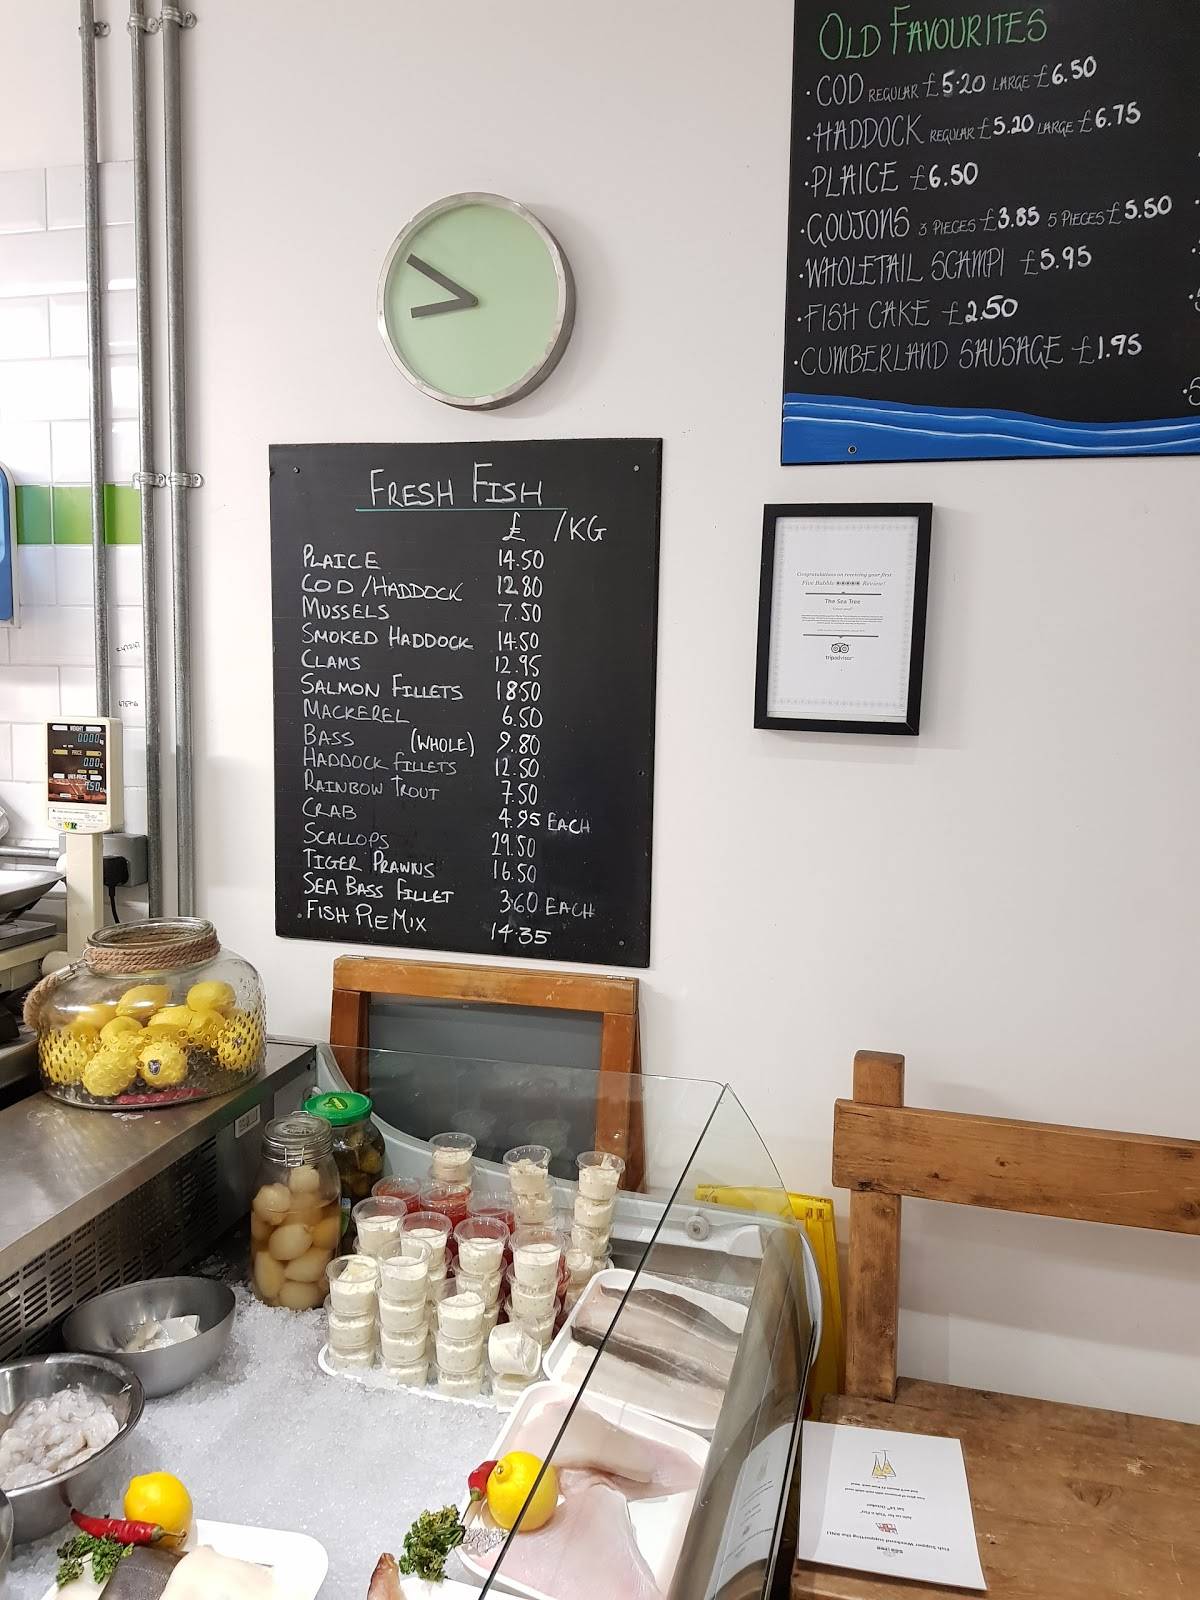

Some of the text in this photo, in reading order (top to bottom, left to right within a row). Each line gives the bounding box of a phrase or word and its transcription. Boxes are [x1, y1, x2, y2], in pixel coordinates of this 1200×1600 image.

[819, 5, 1047, 60] OLD FAVOURITES
[817, 73, 863, 106] COD
[869, 84, 919, 102] REGULAR
[993, 75, 1030, 91] LARGE
[1034, 56, 1096, 87] £6.50
[813, 102, 1141, 153] HADDOCK REGULAR £5.20 LARGE £6.75
[811, 161, 978, 197] PLAICE £6.50
[807, 195, 1172, 248] GOUJONS 3 PIECES £3.85 5 PIECES £5.50
[805, 245, 1091, 288] WHOLETAIL SCAMPI £5.95
[804, 295, 1018, 332] FISH CAKE £2.50
[801, 334, 1142, 375] CUMBERLAND SAUSAGE £1.95
[371, 462, 542, 507] FRESH FISH
[303, 544, 544, 570] PLAICE 14.50
[302, 576, 353, 594] COD
[303, 598, 541, 622] MUSSELS 7.50
[302, 623, 538, 651] SMOKED HADDOCK 14.50
[301, 649, 542, 677] CLAMS 12.95
[301, 673, 379, 697] SALMON
[392, 673, 463, 700] FILLETS
[304, 698, 542, 728] MACKEREL 6.50
[304, 723, 354, 746] BASS
[411, 728, 474, 757] (WHOLE)
[304, 746, 539, 778] HADDOCK FILLETS 12.50
[305, 770, 537, 805] RAINBOW TROUT 7.50
[302, 797, 589, 834] CRAB 4.95 EACH
[304, 822, 389, 849] SCALLOPS
[303, 848, 536, 883] TIGER PRAWNS 16.50
[303, 872, 338, 895] SEA
[346, 875, 383, 898] BASS
[397, 878, 454, 903] FILLET
[546, 897, 594, 919] EACH
[308, 900, 349, 923] FISH
